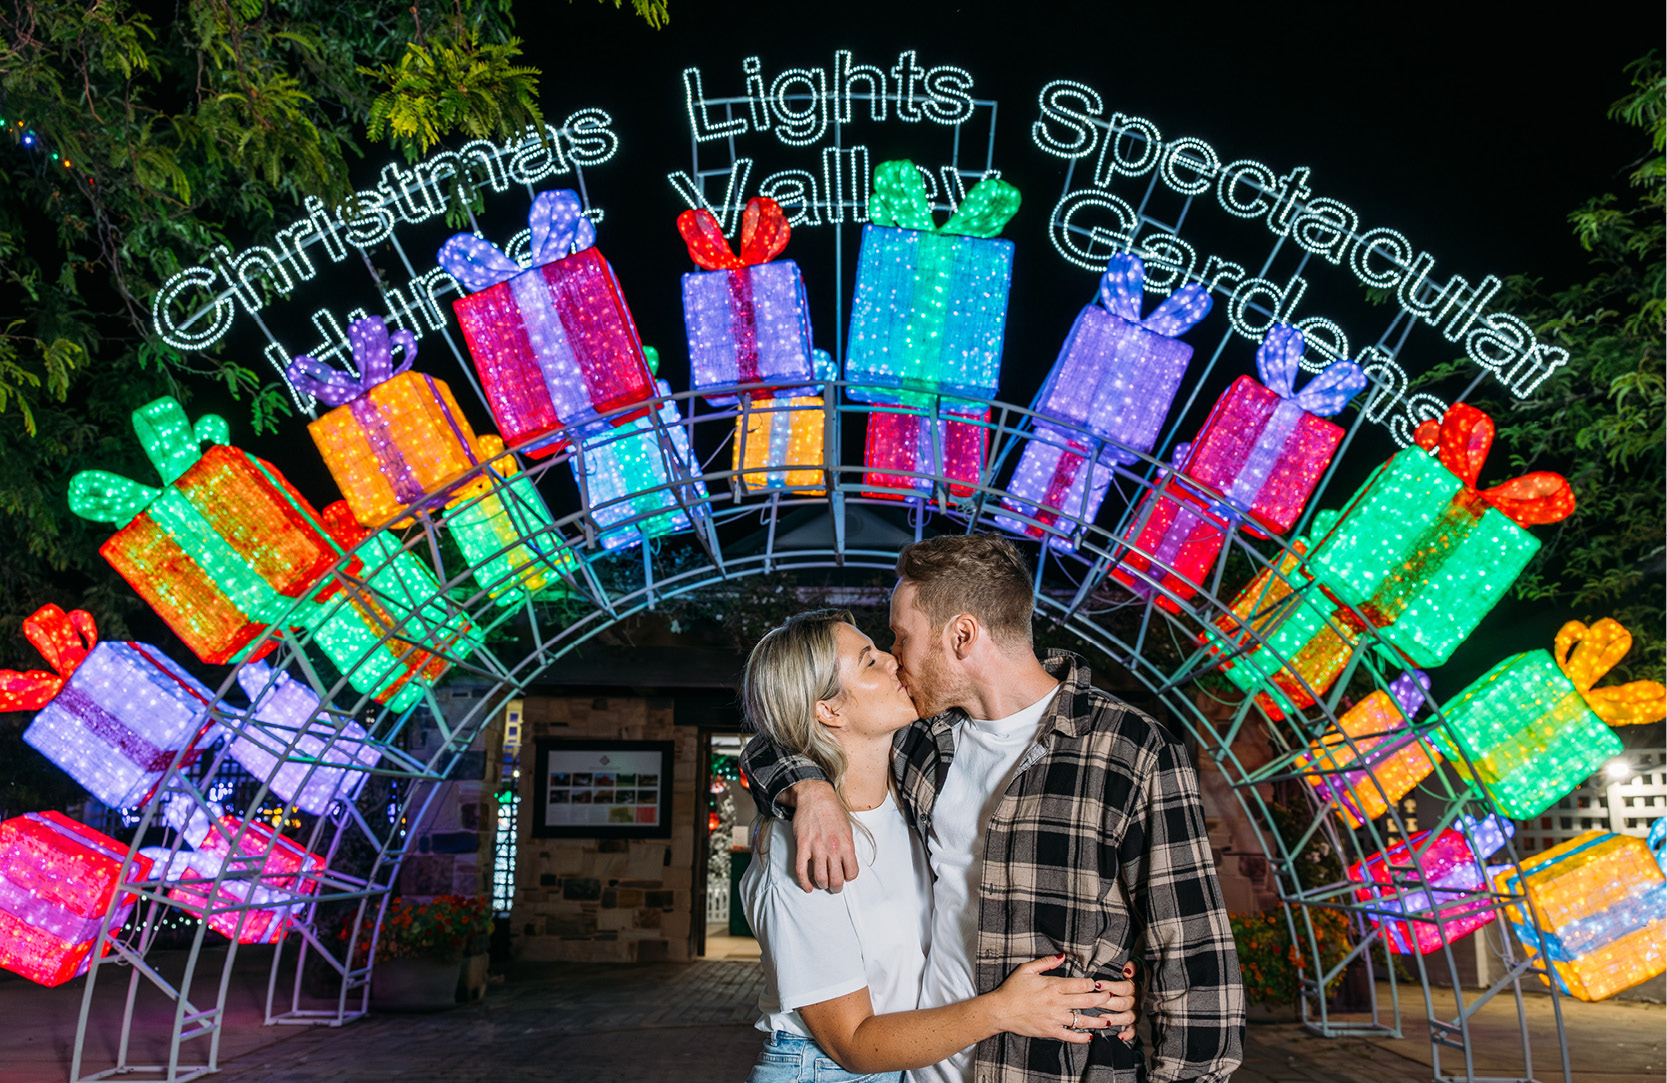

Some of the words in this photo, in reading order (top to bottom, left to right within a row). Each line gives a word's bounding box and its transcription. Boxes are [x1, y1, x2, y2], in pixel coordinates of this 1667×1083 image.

[151, 106, 620, 352] Christmas
[682, 49, 976, 147] Lights
[1031, 78, 1571, 400] Spectacular
